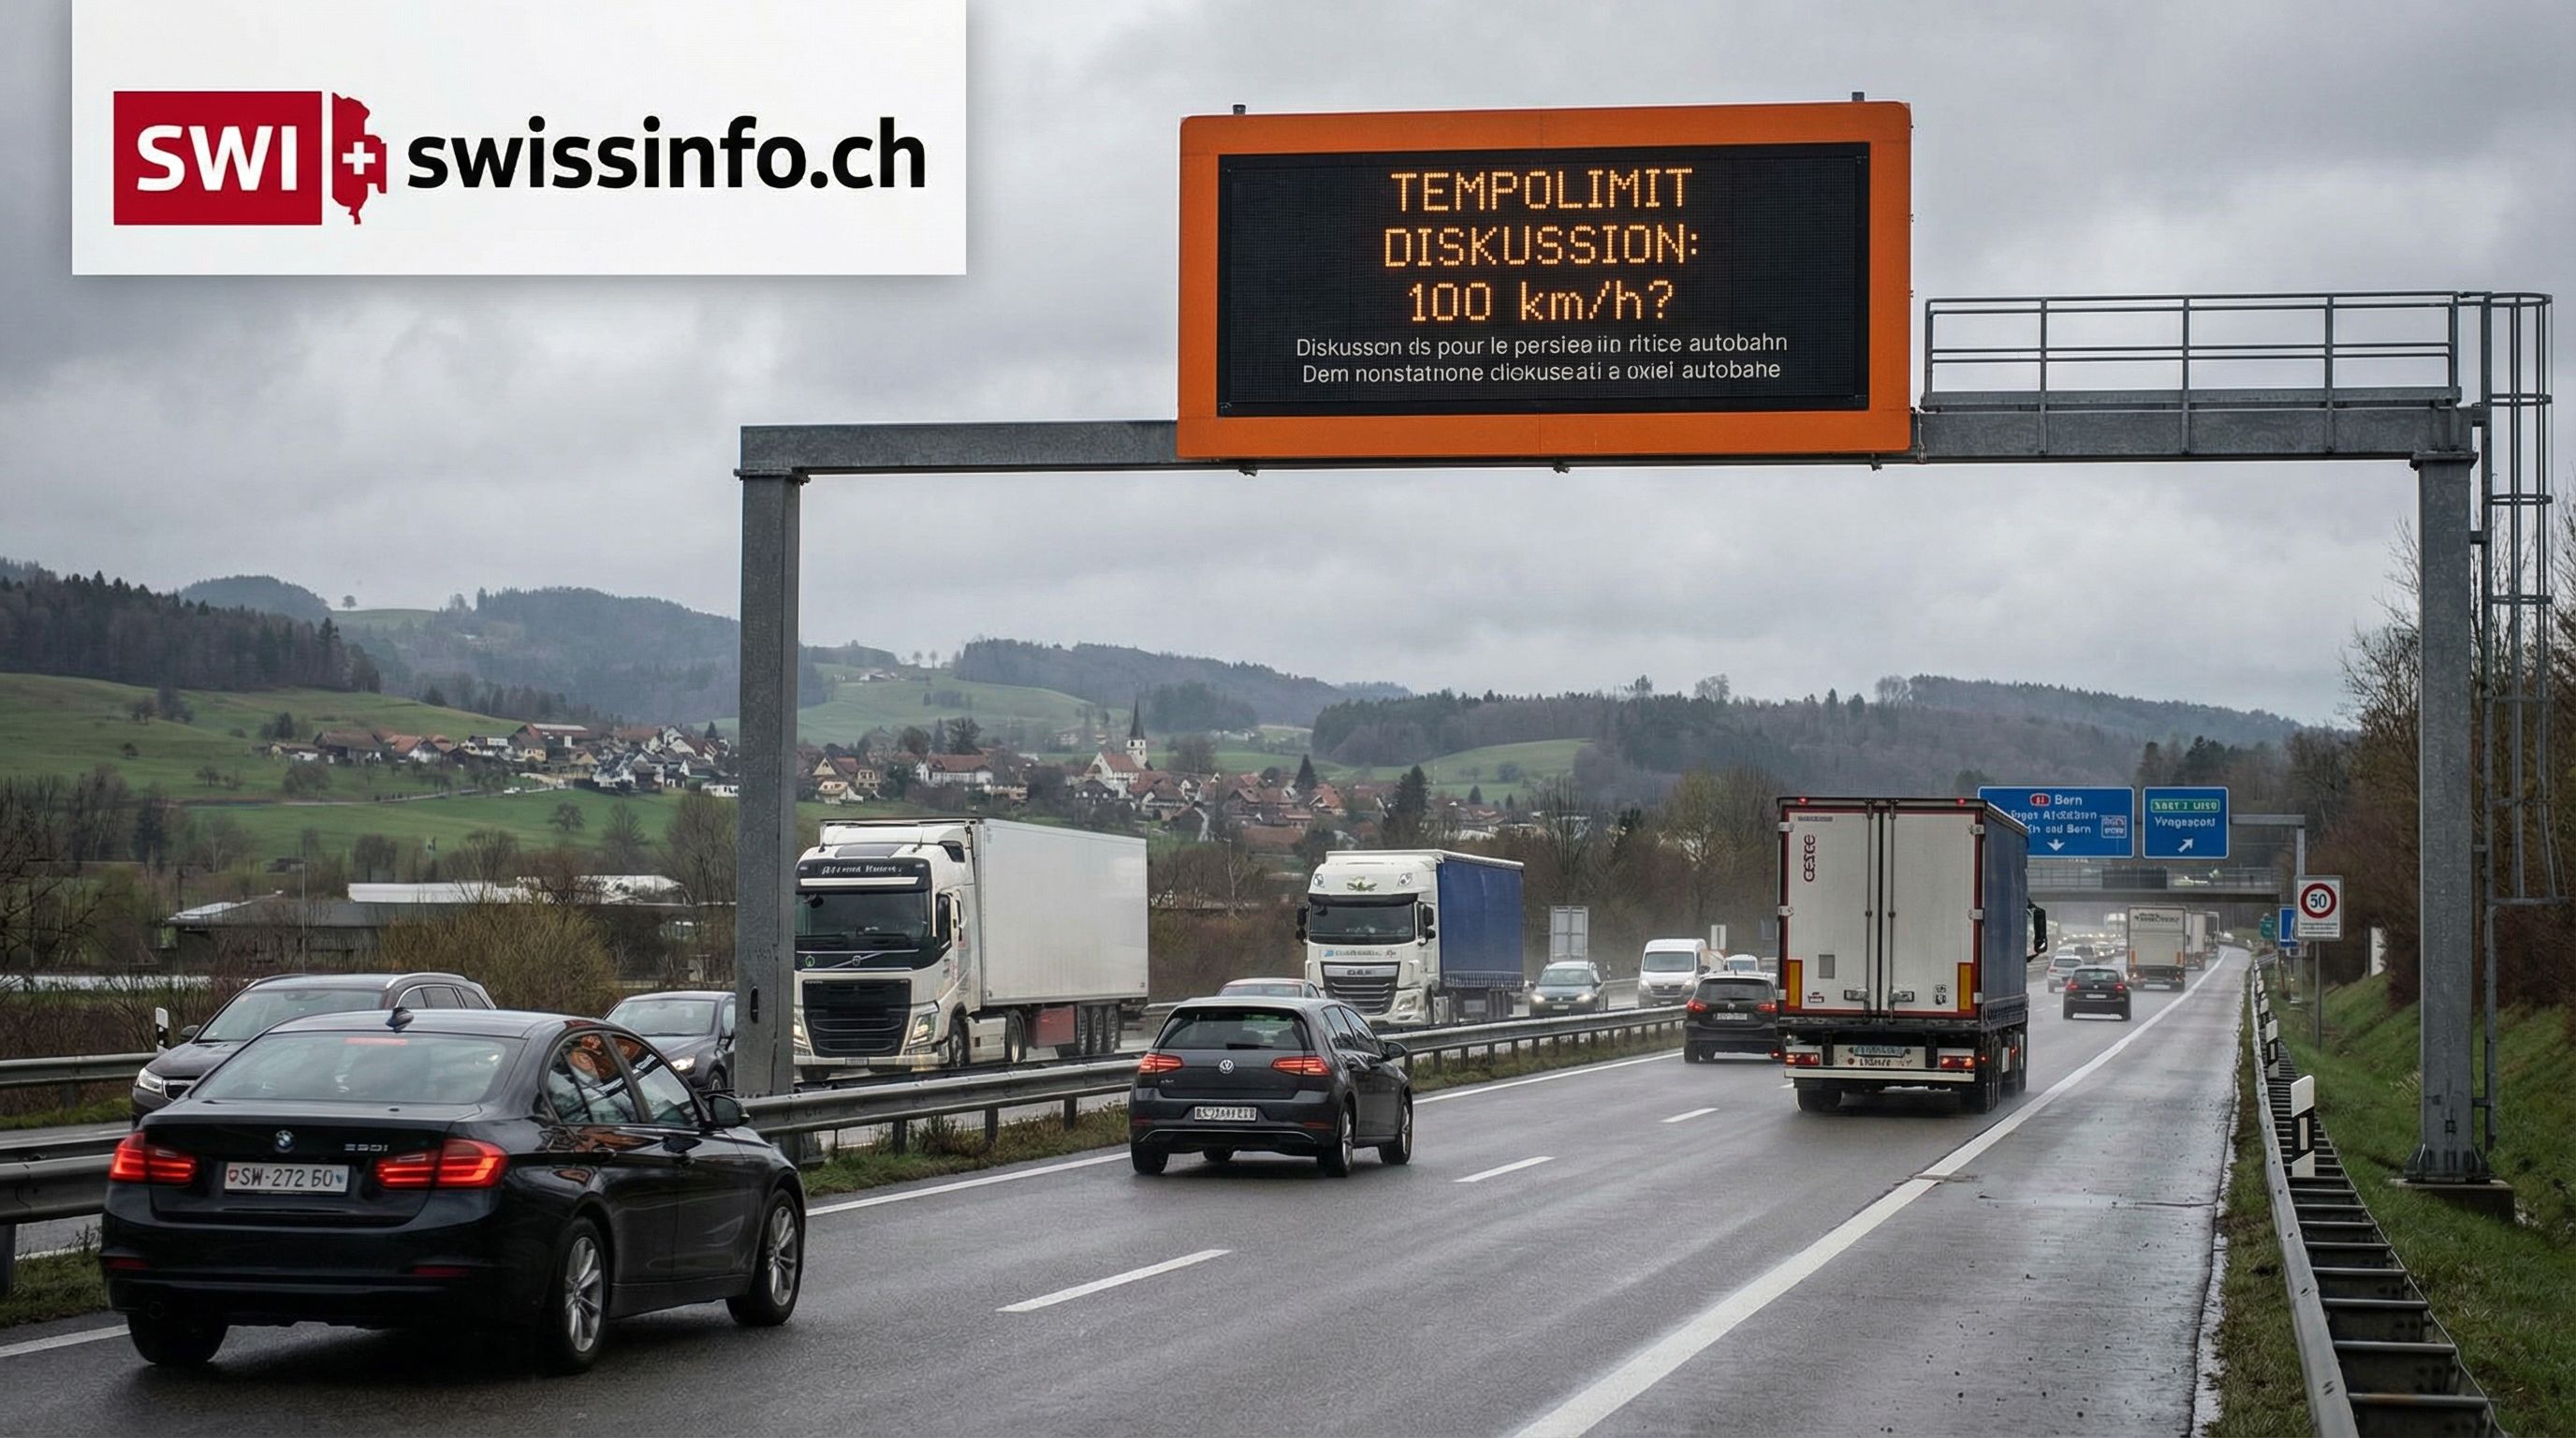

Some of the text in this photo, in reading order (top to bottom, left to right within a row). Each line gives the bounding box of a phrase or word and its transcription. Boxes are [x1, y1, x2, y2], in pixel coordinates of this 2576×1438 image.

[1391, 167, 1692, 213] TEMPOLIMIT
[1384, 223, 1699, 269] DISKUSSION:
[1410, 279, 1675, 323] 100 km/h?
[1438, 340, 1485, 360] pour
[1491, 336, 1508, 355] le
[1689, 332, 1788, 352] autobahn
[1303, 364, 1349, 383] Dem
[1608, 366, 1620, 379] a
[2310, 893, 2327, 908] 50
